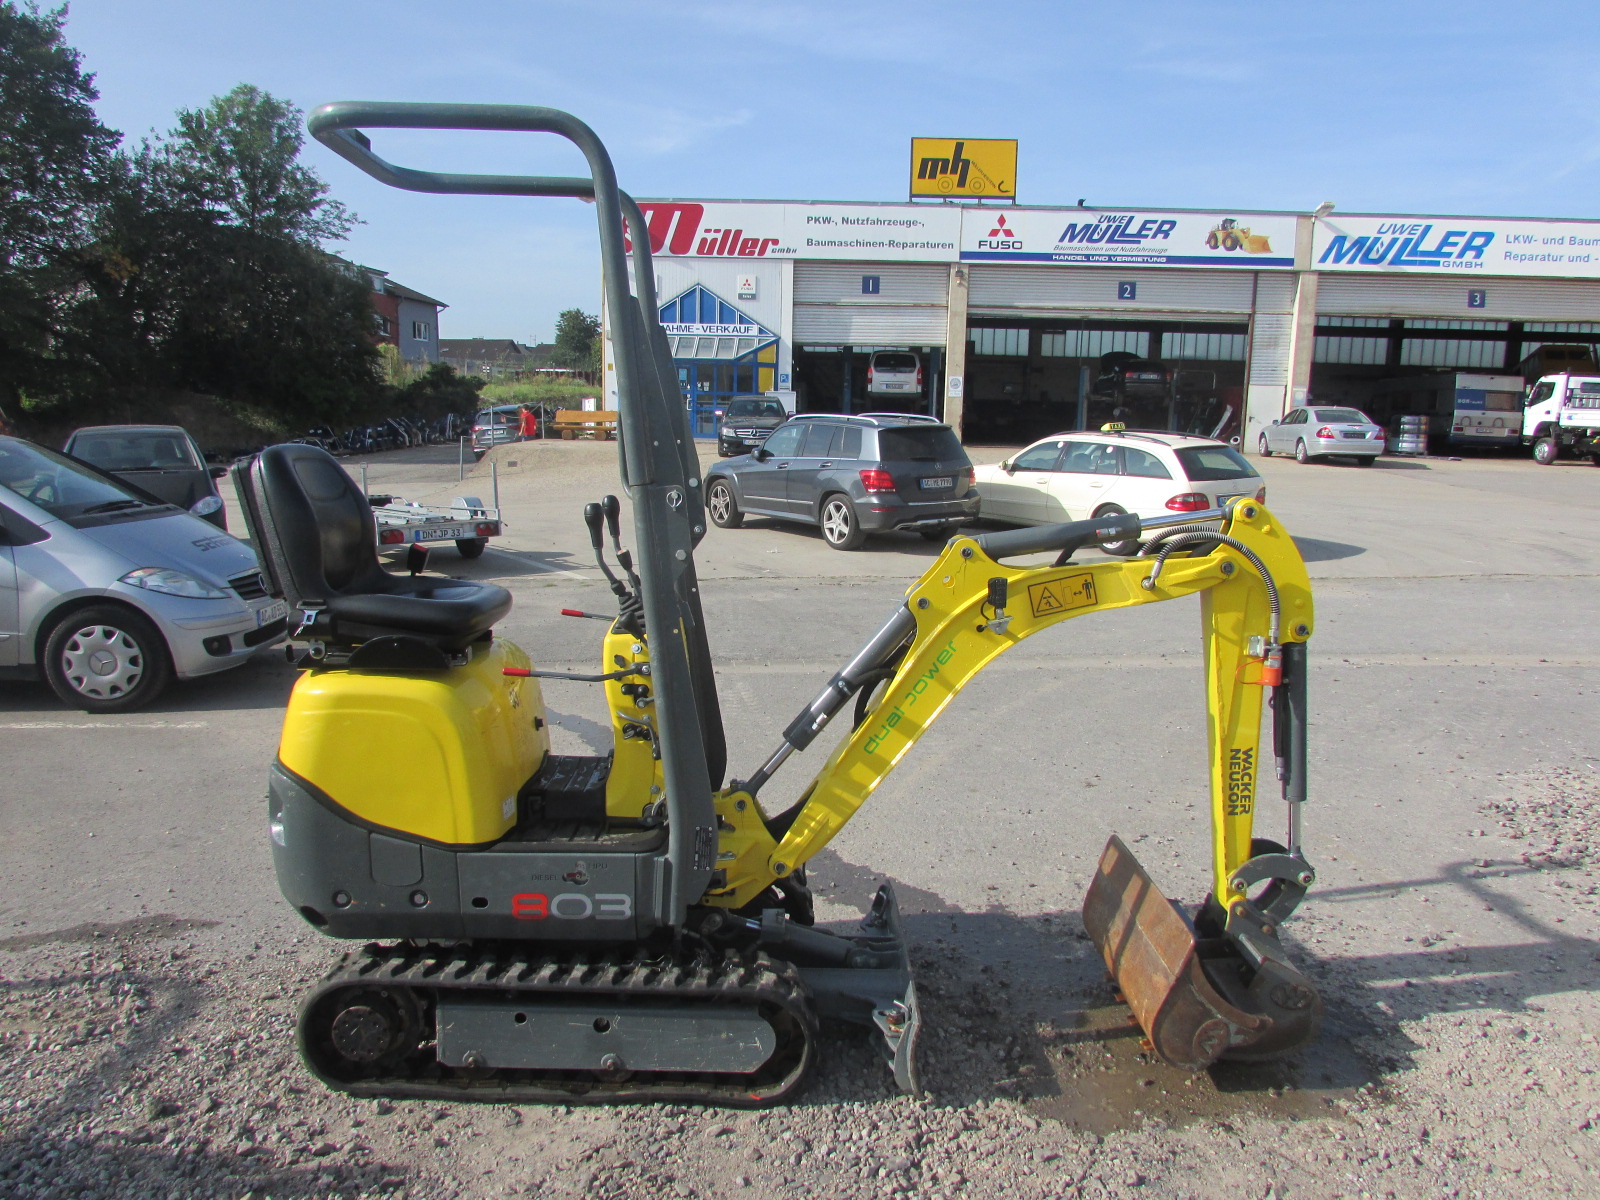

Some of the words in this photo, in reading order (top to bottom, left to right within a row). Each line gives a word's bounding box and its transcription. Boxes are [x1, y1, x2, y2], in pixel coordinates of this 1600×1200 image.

[918, 142, 970, 188] mh
[806, 216, 838, 226] PKW-,
[841, 216, 925, 228] Nutzfahrzeuge-,
[1098, 215, 1128, 224] UWE
[1058, 216, 1177, 245] MÜLLER
[1377, 223, 1422, 235] UWE
[806, 238, 954, 250] Baumaschinen-Reparaturen
[978, 240, 1022, 250] FUSO
[1506, 234, 1537, 244] LKW-
[1542, 236, 1564, 245] und
[1053, 244, 1104, 252] Baumaschinen
[1118, 246, 1168, 254] Nutzfahrzeuge
[1318, 225, 1495, 267] MÜLLER
[1504, 251, 1563, 263] Reparatur
[1568, 253, 1590, 263] und
[1442, 260, 1483, 268] GMBH
[1123, 285, 1131, 297] 2
[1473, 293, 1480, 305] 3
[422, 531, 433, 539] DN
[451, 529, 461, 537] 33
[863, 706, 905, 754] dual
[1228, 748, 1241, 816] NEUSON
[1239, 747, 1253, 815] WACKER
[511, 893, 632, 920] 803
